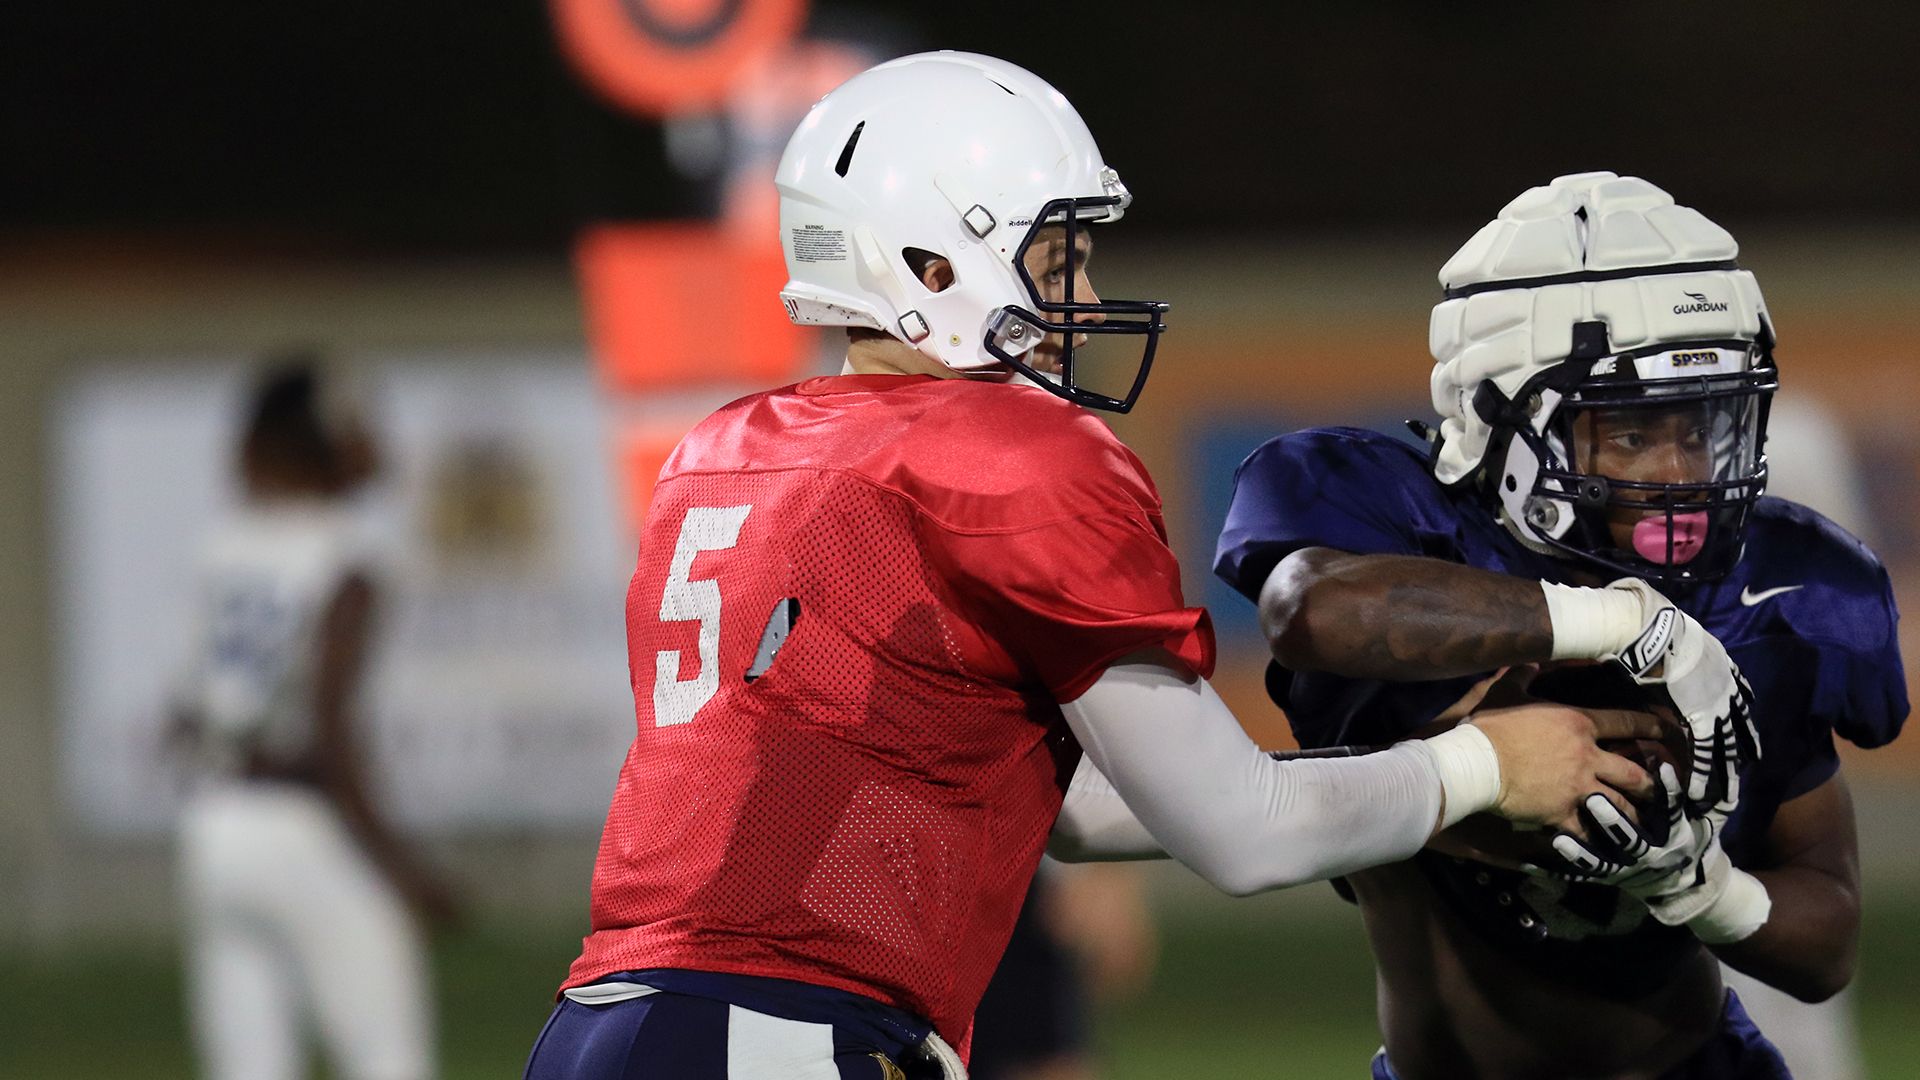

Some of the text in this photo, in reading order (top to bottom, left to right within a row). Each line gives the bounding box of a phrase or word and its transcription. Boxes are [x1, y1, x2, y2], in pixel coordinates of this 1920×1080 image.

[1009, 219, 1033, 227] Riddell
[1673, 302, 1728, 314] GUARDIAN
[1671, 351, 1719, 367] SPEED
[652, 504, 753, 728] 5
